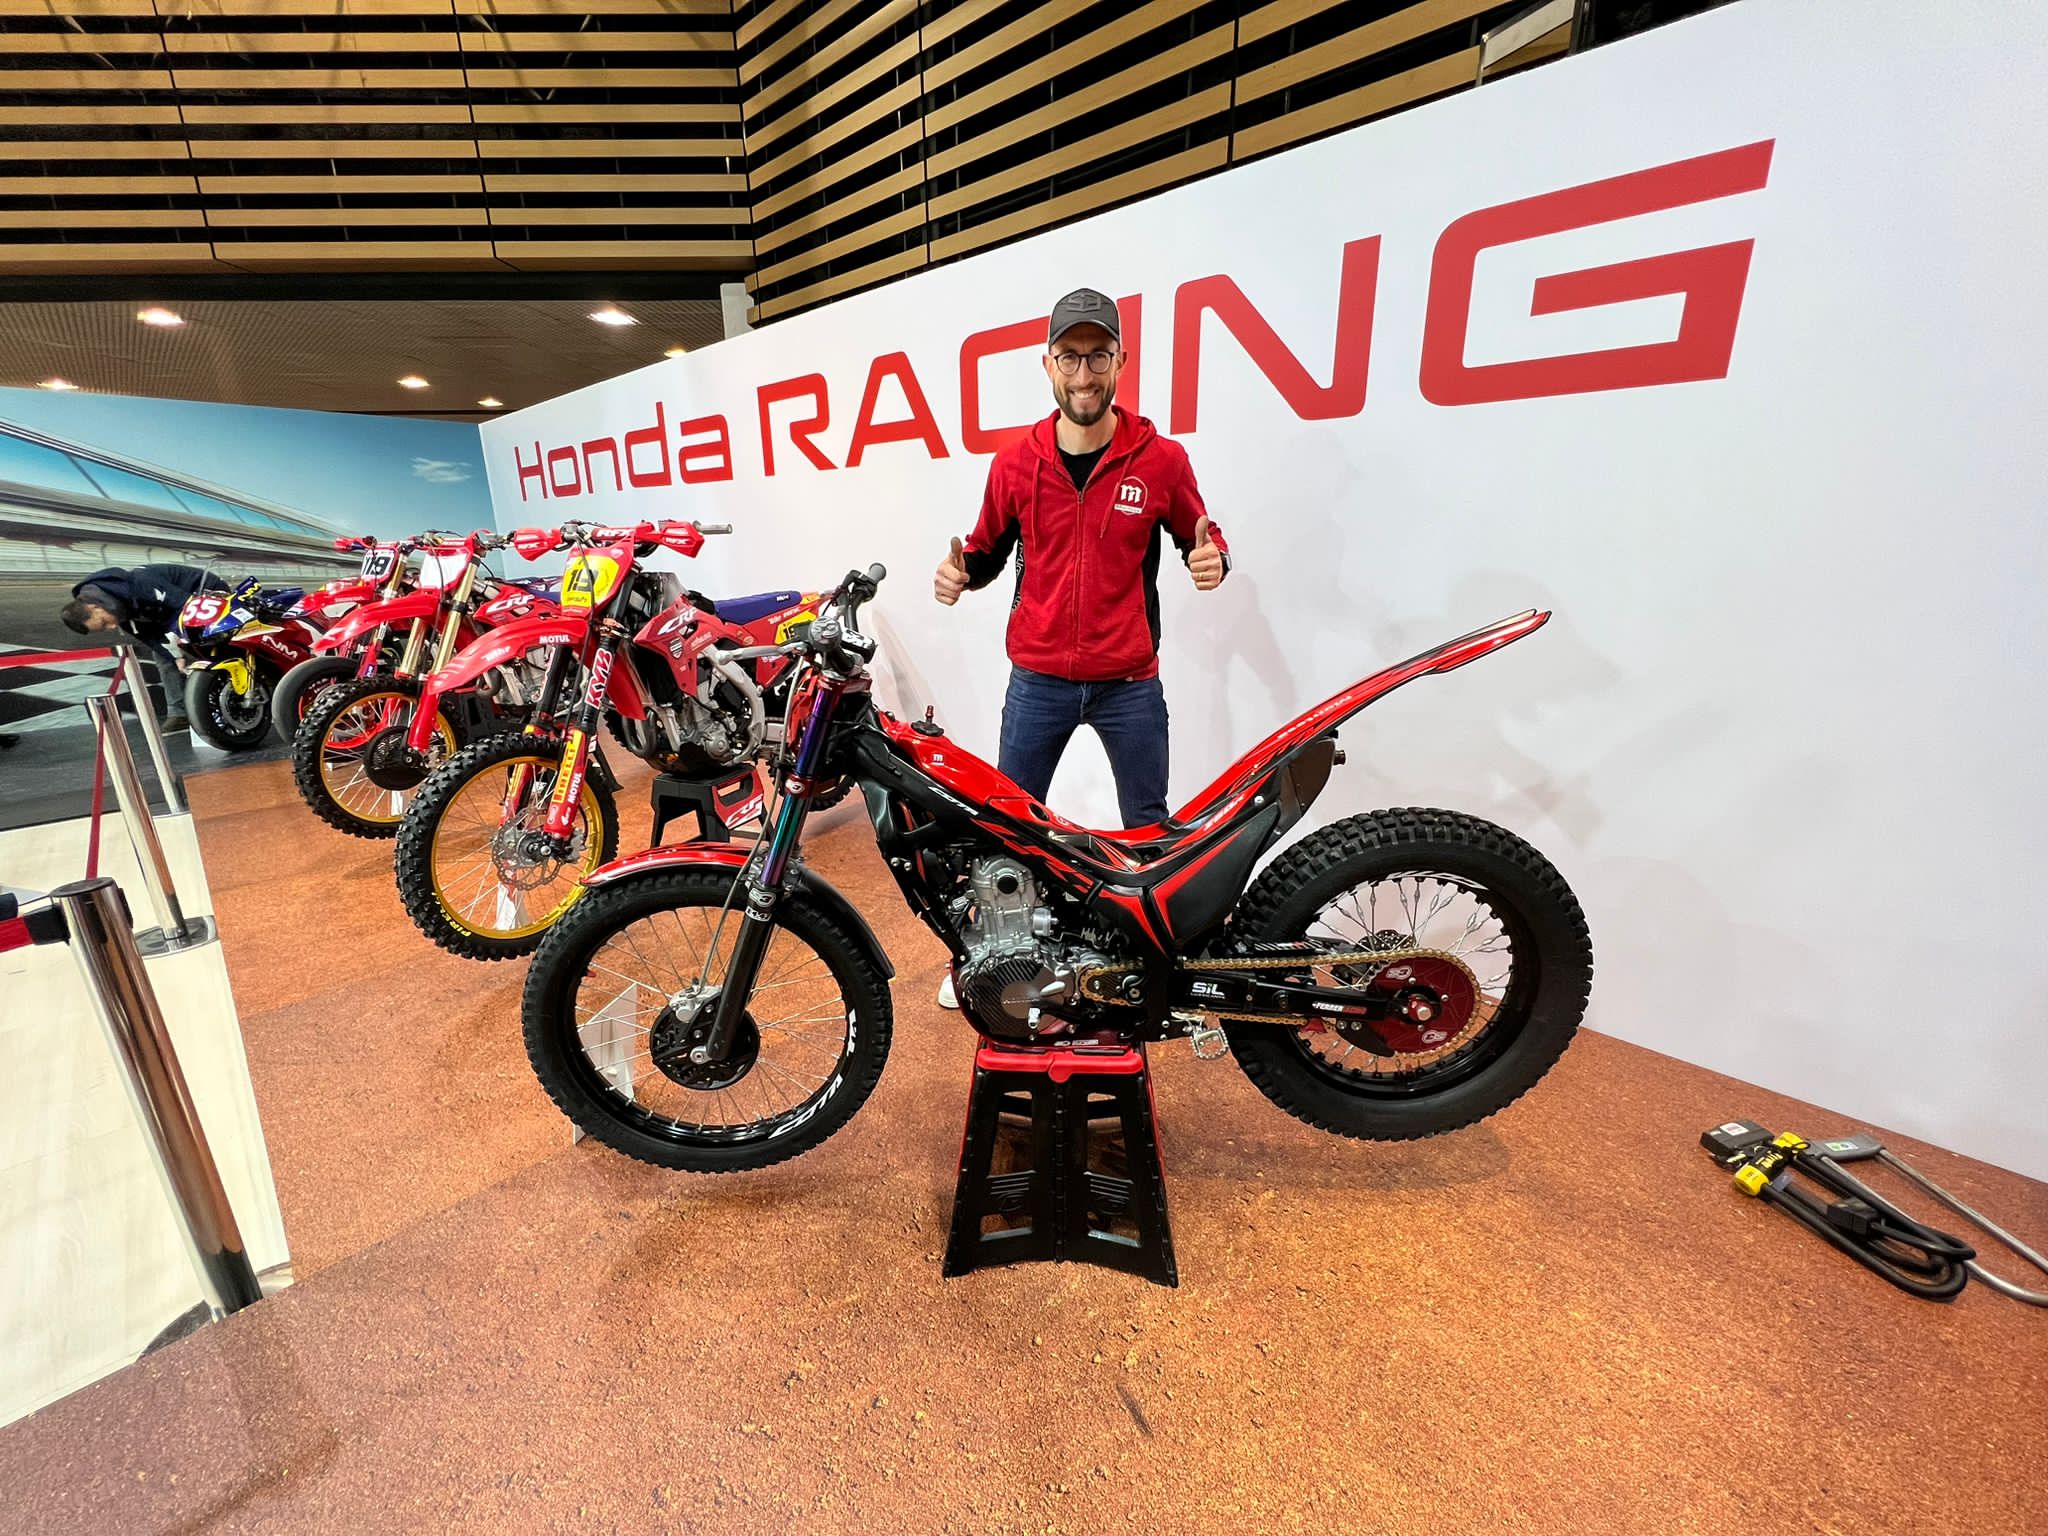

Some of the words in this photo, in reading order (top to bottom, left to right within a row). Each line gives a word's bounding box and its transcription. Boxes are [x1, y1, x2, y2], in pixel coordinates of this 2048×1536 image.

[514, 401, 734, 502] Honda
[756, 138, 1776, 476] RACING
[539, 634, 571, 644] MOTUL
[584, 647, 613, 709] KYB
[567, 772, 582, 804] MOTUL
